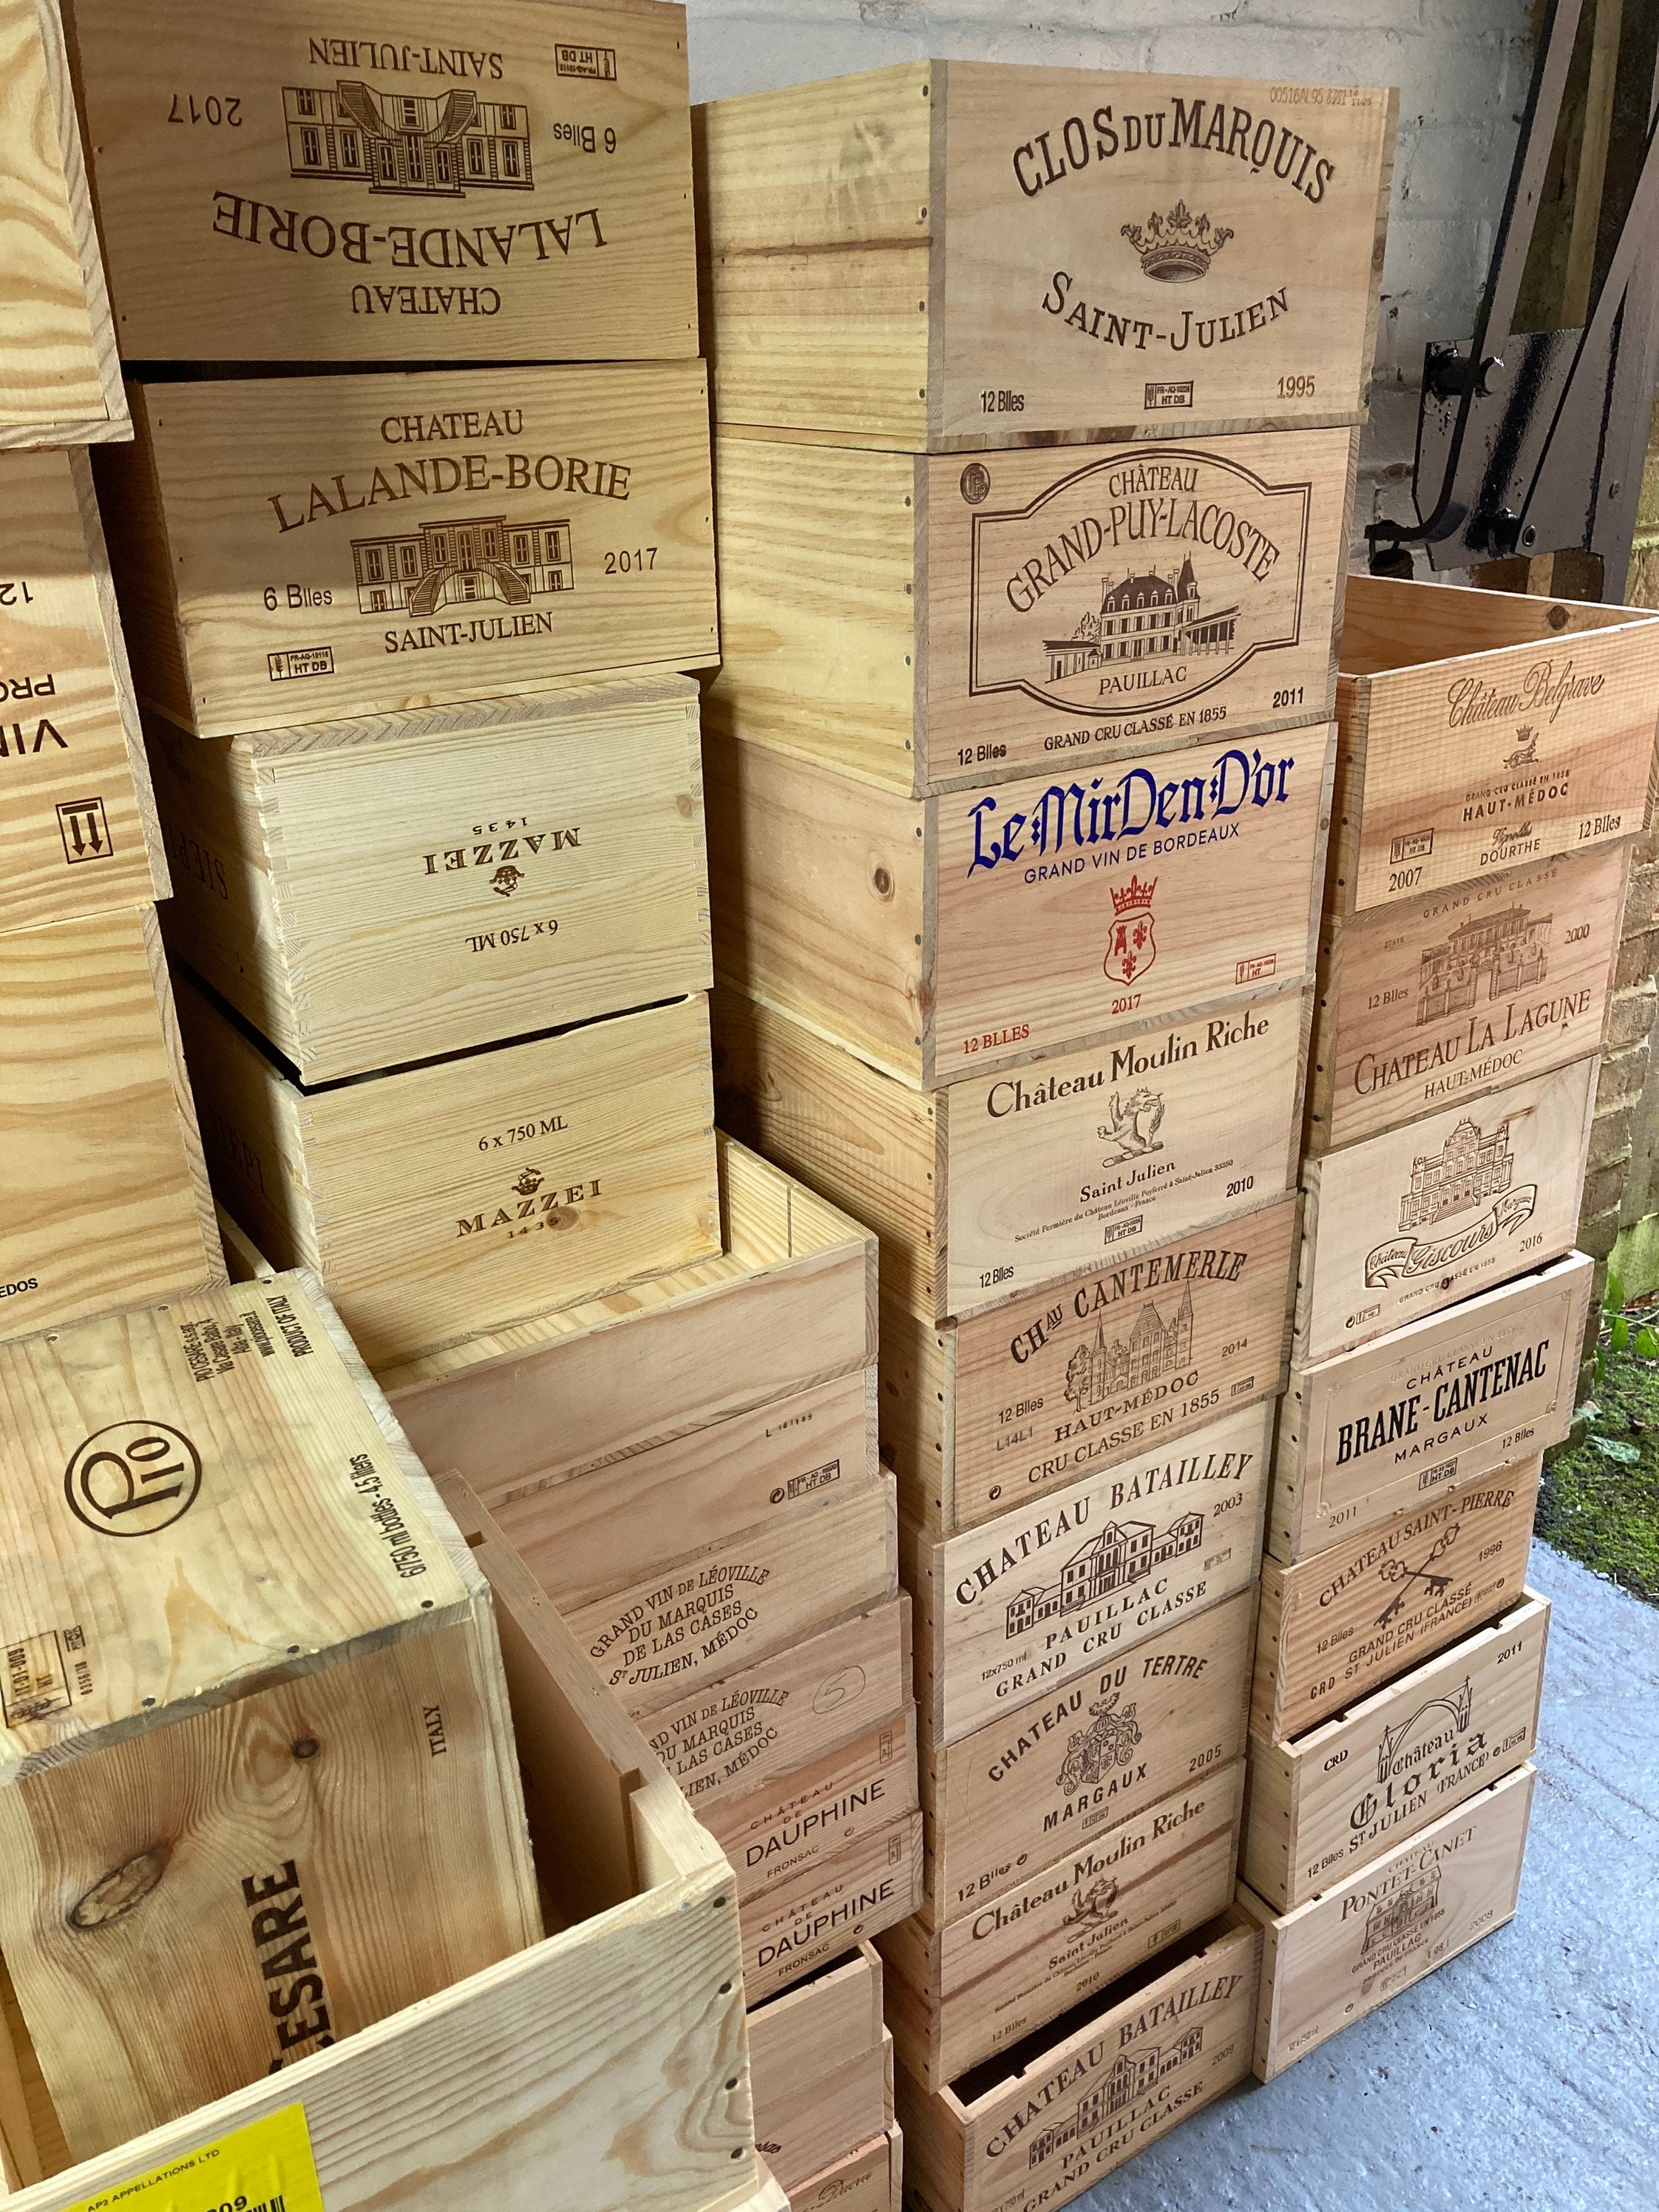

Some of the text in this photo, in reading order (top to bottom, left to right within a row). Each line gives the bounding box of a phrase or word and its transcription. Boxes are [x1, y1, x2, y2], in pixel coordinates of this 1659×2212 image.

[309, 38, 503, 79] SAINT-JULIEN
[168, 93, 242, 126] 2017
[604, 126, 617, 154] 6
[1014, 98, 1335, 203] CLOS MARQUIS
[213, 191, 608, 267] LALANDE-BORIE
[351, 285, 501, 314] CHATEAU
[1042, 271, 1289, 351] SAINT-JULIEN
[980, 390, 995, 413] 12
[1277, 376, 1316, 399] 1995
[381, 410, 523, 444] CHATEAU
[268, 454, 631, 533] LALANDE-BORIE
[1109, 463, 1198, 497] CHÂTEAU
[604, 548, 658, 574] 2017
[1006, 497, 1280, 614] GRAND-PUY-LACOSTE
[263, 586, 278, 611] 6
[385, 611, 553, 653] SAINT-JULIEN
[294, 660, 328, 674] HT DB
[1099, 666, 1187, 695] PAUILLAC
[1272, 687, 1304, 708] 2011
[1518, 659, 1604, 722] Belgrave
[1044, 706, 1227, 751] GRAND CRU CLASSÉ EN 1855
[1462, 783, 1568, 821] HAUT-MÉDOC
[1465, 789, 1490, 802] GRAND
[472, 817, 528, 835] 1435
[422, 827, 582, 875] MAZZEI
[1024, 823, 1240, 883] GRAND VIN DE BORDEAUX
[1480, 838, 1541, 866] DOURTHE
[1388, 866, 1422, 892] 2007
[1423, 886, 1502, 918] GRAND CRU
[1564, 923, 1590, 944] 2000
[1112, 994, 1141, 1015] 2017
[963, 1024, 1030, 1054] 12 BLLES
[1354, 989, 1591, 1096] CHATEAU LAGUNE
[987, 1010, 1269, 1118] Château Moulin Riche
[1424, 1049, 1523, 1099] HAUT-MÉDOC
[1079, 1161, 1175, 1203] Saint Julien
[1226, 1175, 1255, 1198] 2010
[455, 1179, 602, 1238] MAZZEI
[1085, 1204, 1113, 1218] Château
[1113, 1193, 1139, 1206] Léoville
[1097, 1196, 1156, 1221] Bordeaux France
[1406, 1224, 1495, 1275] Giscours
[1519, 1232, 1543, 1253] 2016
[1073, 1249, 1248, 1318] CANTEMERLE
[1399, 1288, 1423, 1303] GRAND
[223, 1323, 251, 1354] Alba Italy
[275, 1314, 314, 1357] PRODUCT OF
[1222, 1337, 1248, 1357] 2014
[194, 1368, 215, 1382] PIO
[216, 1360, 234, 1374] Via
[1407, 1346, 1493, 1390] CHÂTEAU
[1336, 1339, 1550, 1466] BRANE-CANTENAC
[1028, 1389, 1220, 1484] CRU CLASSE EN 1855
[1394, 1413, 1488, 1464] MARGAUX
[370, 1498, 404, 1535] bottles
[1213, 1492, 1243, 1517] 2003
[1329, 1506, 1357, 1528] 2011
[381, 1530, 413, 1547] ml
[955, 1453, 1253, 1606] CHATEAU BATAILLEY
[1479, 1541, 1502, 1562] 1996
[1319, 1536, 1400, 1607] CHATEAU
[590, 1564, 770, 1658] GRAND VIN DE LÉOVILLE
[622, 1601, 742, 1666] DE LAS CASES
[628, 1584, 734, 1643] DU MARQUIS
[702, 1607, 758, 1658] MÉDOC
[1045, 1578, 1167, 1651] PAUILLAC
[996, 1581, 1207, 1697] GRAND CRU CLASSE
[1345, 1598, 1472, 1680] ST JULIEN (FRANCE)
[1349, 1612, 1423, 1663] GRAND CRU
[1496, 1641, 1522, 1664] 2011
[423, 1704, 447, 1757] ITALY
[671, 1688, 790, 1735] VIN DE LÉOVILLE
[683, 1706, 755, 1753] MARQUIS
[988, 1655, 1207, 1782] CHATEAU DU TERTRE
[677, 1722, 763, 1775] LAS CASES
[725, 1728, 778, 1778] MÉDOC
[1189, 1744, 1221, 1772] 2005
[1393, 1728, 1453, 1776] Château
[1043, 1763, 1147, 1832] MARGAUX
[1350, 1730, 1487, 1830] Gloria
[746, 1777, 886, 1867] DAUPHINE
[750, 1782, 834, 1831] CHÂTEAU
[784, 1811, 801, 1825] DE
[1368, 1791, 1428, 1839] JULIEN
[767, 1845, 820, 1879] FRONSAC
[972, 1800, 1205, 1940] Château Moulin Riche
[1340, 1825, 1477, 1922] PONTET-CANET
[758, 1879, 894, 1968] DAUPHINE
[762, 1884, 843, 1933] CHÂTEAU
[240, 1858, 337, 2075] ESARE
[778, 1943, 830, 1977] FRONSAC
[1048, 1941, 1086, 1970] Saint
[1373, 1933, 1422, 1970] PAUILLAC
[1377, 1944, 1392, 1958] CRU
[986, 1975, 1244, 2158] CHATEAU BATAILLEY
[1062, 2086, 1170, 2170] PAUILLAC
[1097, 2081, 1204, 2163] CRU CLASSE
[112, 2149, 220, 2203] APPELLATIONS LTD
